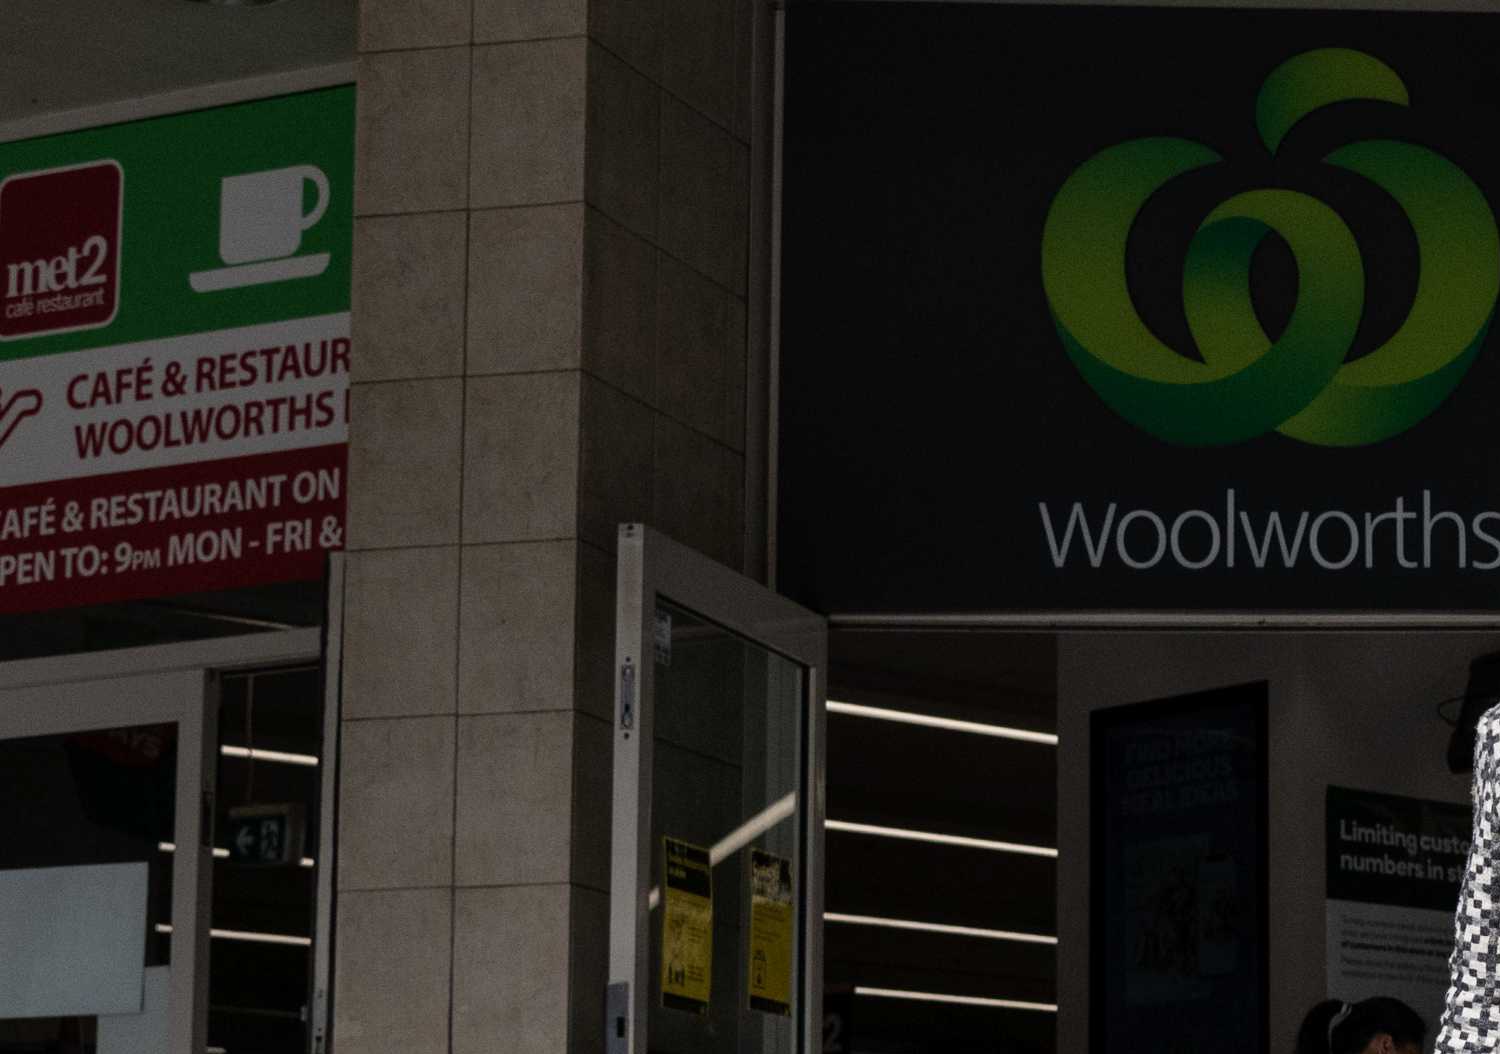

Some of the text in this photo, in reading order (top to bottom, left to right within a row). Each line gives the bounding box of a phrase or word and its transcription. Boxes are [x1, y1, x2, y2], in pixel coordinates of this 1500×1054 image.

[6, 234, 108, 299] met2
[66, 337, 350, 409] CAFÉ & RESTAUR
[75, 391, 334, 459] WOOLWORTHS
[62, 500, 85, 534] &
[90, 473, 289, 530] RESTAURANT
[292, 466, 342, 505] ON
[61, 545, 110, 579] TO:
[114, 541, 162, 574] 9PM
[167, 526, 244, 568] MON
[265, 517, 313, 555] FRI
[319, 514, 344, 549] &
[1340, 818, 1470, 857] Limiting custo
[1340, 852, 1425, 878] numbers
[1427, 859, 1444, 880] in
